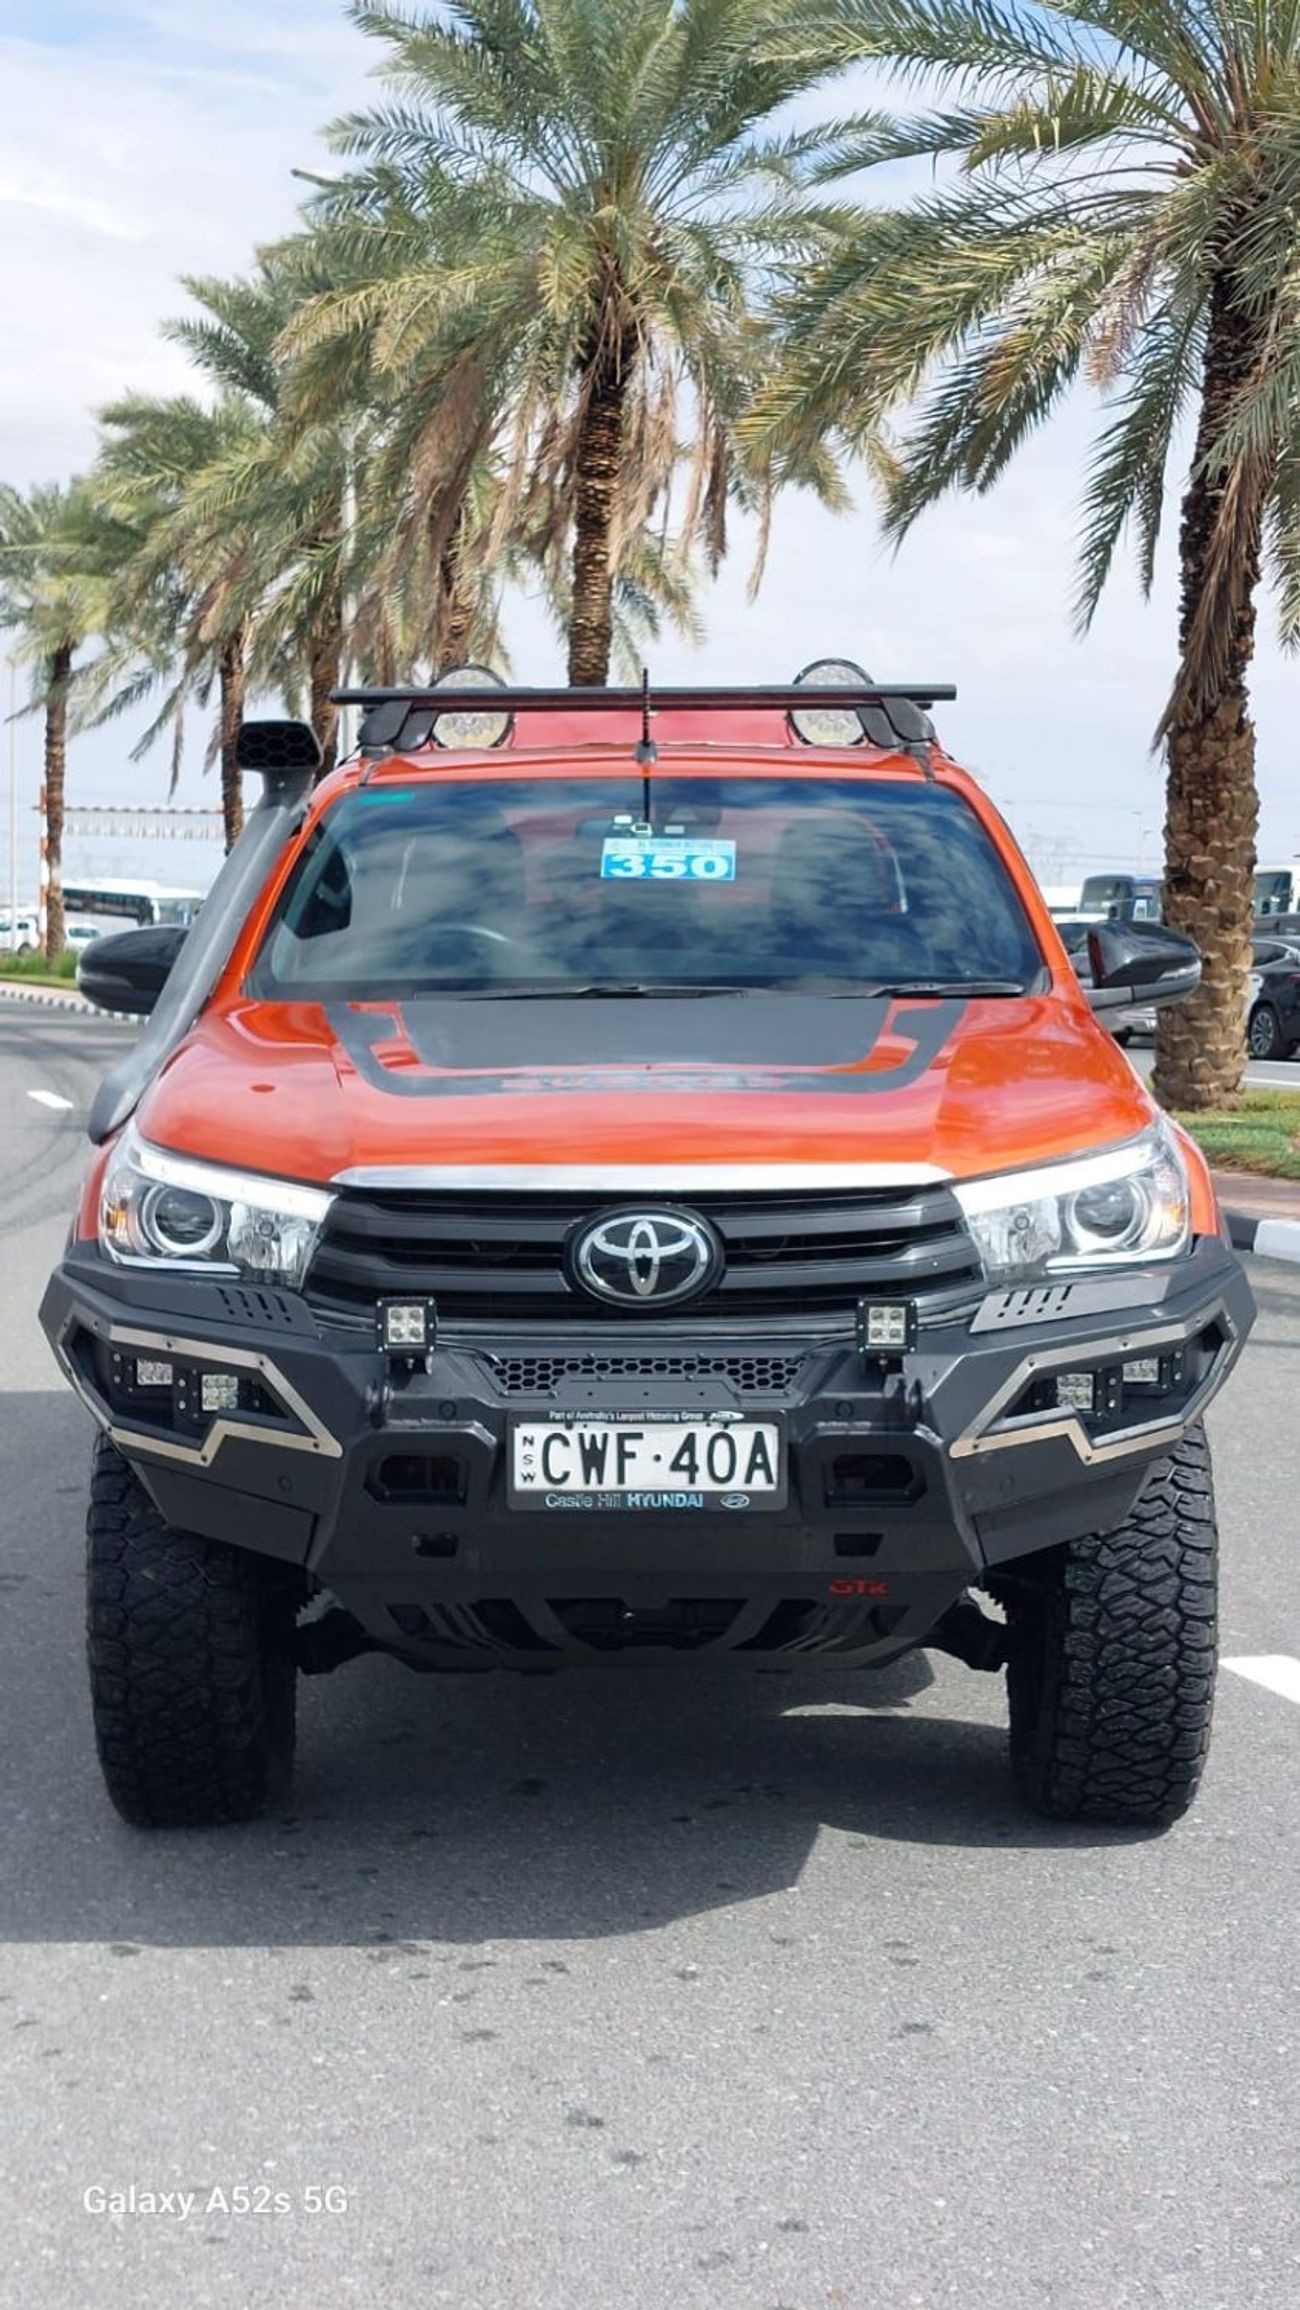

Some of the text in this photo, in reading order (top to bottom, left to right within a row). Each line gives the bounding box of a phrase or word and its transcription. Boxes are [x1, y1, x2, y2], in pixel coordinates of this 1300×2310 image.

[609, 854, 730, 878] 350
[545, 1493, 704, 1508] Castle Hill HYUNDAI
